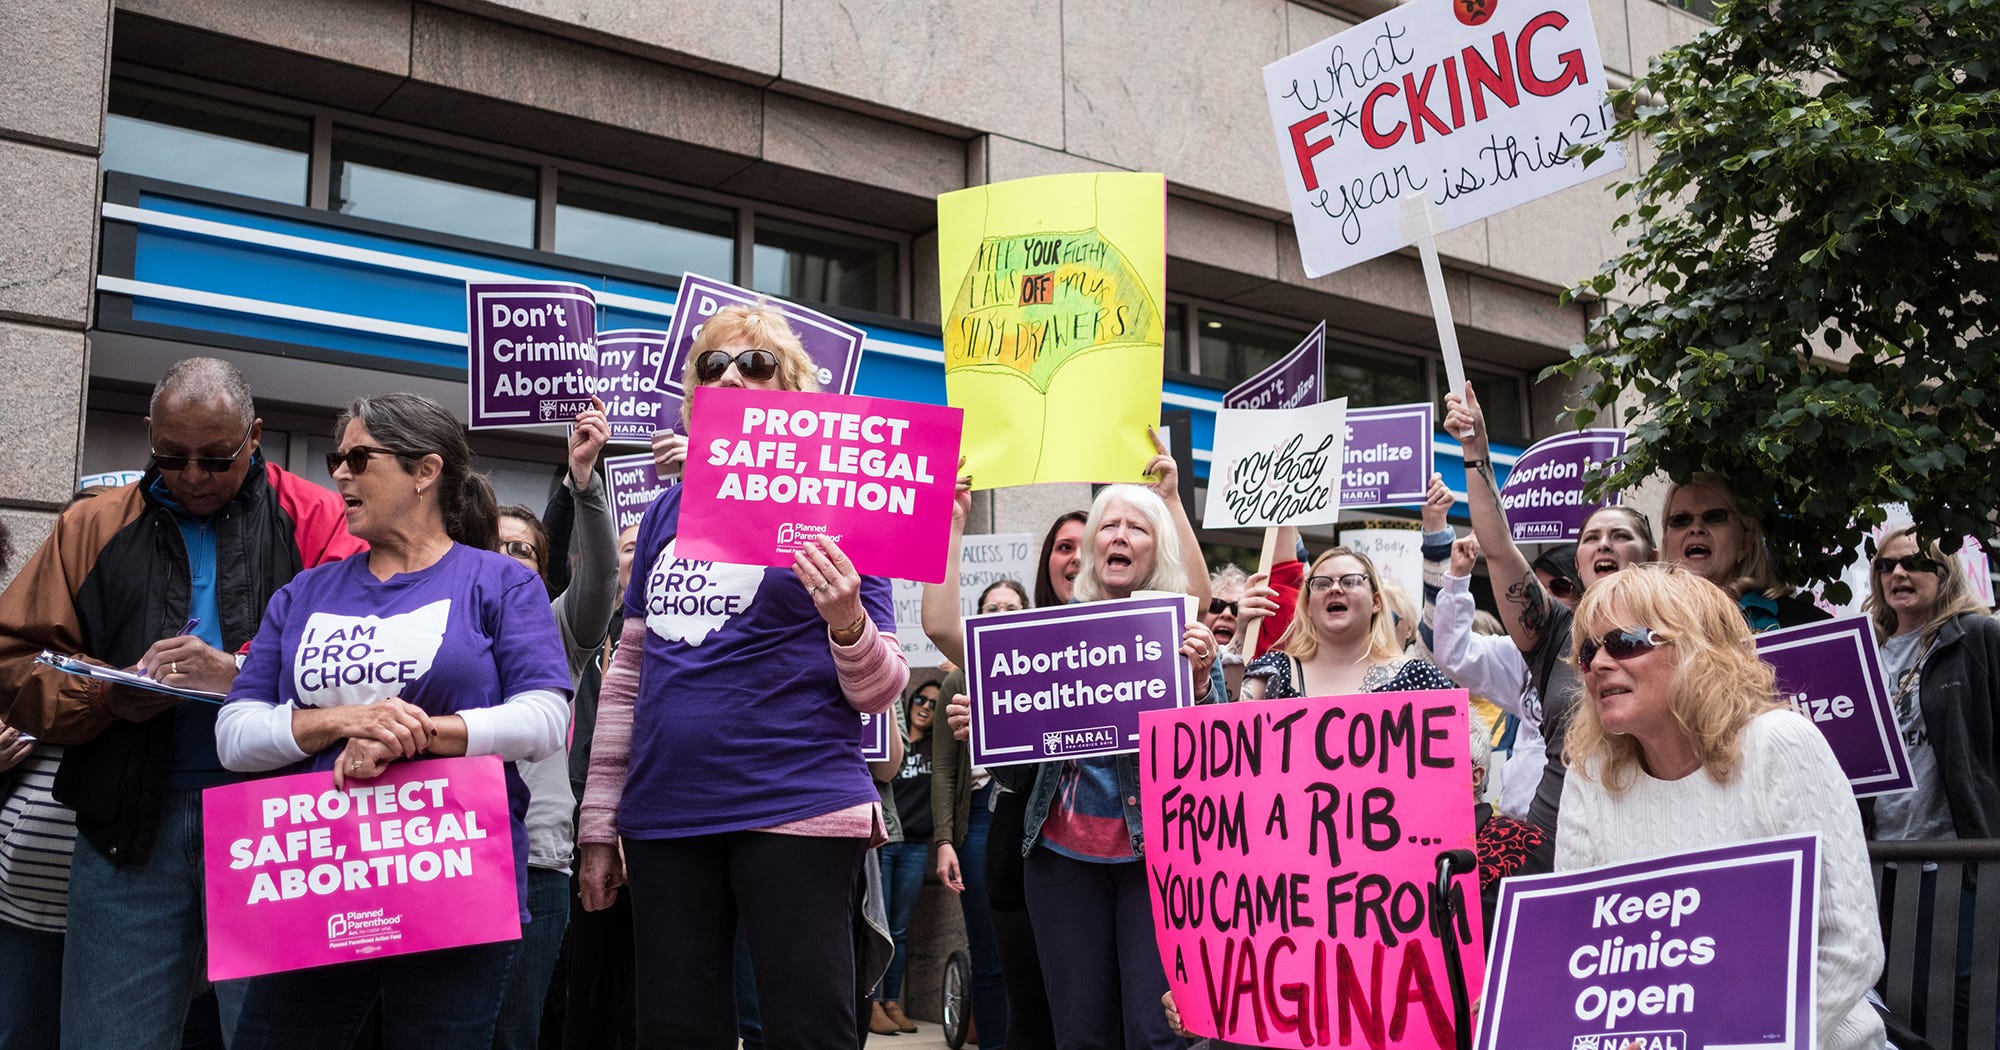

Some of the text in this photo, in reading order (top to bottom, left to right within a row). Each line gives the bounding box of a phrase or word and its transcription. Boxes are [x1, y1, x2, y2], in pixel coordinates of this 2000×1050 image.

[1283, 22, 1414, 110] what
[1311, 165, 1428, 245] year
[1434, 168, 1485, 205] is
[977, 239, 1110, 271] KEEP YOUR FILTHY
[970, 269, 1016, 308] LAWS
[1022, 275, 1050, 304] OFF
[492, 303, 567, 327] Don't
[1015, 300, 1144, 361] DRAWERS!
[600, 350, 636, 371] my
[597, 371, 654, 392] ortio
[560, 402, 595, 413] NARA
[603, 396, 662, 417] vider
[613, 424, 651, 434] NARAL
[742, 407, 909, 446] PROTECT
[707, 438, 934, 484] SAFE, LEGAL
[1274, 433, 1333, 493] body
[1344, 443, 1413, 464] inalize
[614, 468, 645, 486] Don't
[716, 473, 916, 516] ABORTION
[1342, 491, 1376, 500] NARAL
[795, 523, 827, 532] Planned
[656, 553, 666, 570] I
[962, 543, 1028, 563] ACCESS TO
[650, 573, 718, 593] PRO-
[649, 595, 741, 616] CHOICE
[307, 624, 376, 644] I AM
[301, 643, 384, 666] PRO-
[990, 634, 1162, 678] Abortion is
[300, 660, 417, 691] CHOICE
[992, 678, 1167, 715] Healthcare
[1065, 730, 1113, 745] NARAL
[1151, 702, 1456, 783] I DIDN'T COME
[262, 778, 449, 828] PROTECT
[229, 811, 487, 870] SAFE, LEGAL
[1162, 785, 1249, 865] FROM
[1265, 793, 1288, 840] A
[247, 847, 473, 904] ABORTION
[347, 908, 383, 920] Planned
[1152, 864, 1203, 930] YOU
[1209, 871, 1314, 937] CAME
[1592, 887, 1701, 928] Keep
[348, 915, 400, 929] Parenthood
[1568, 930, 1716, 979] Clinics
[1176, 936, 1457, 1050] A VAGINA
[1575, 983, 1694, 1029] Open
